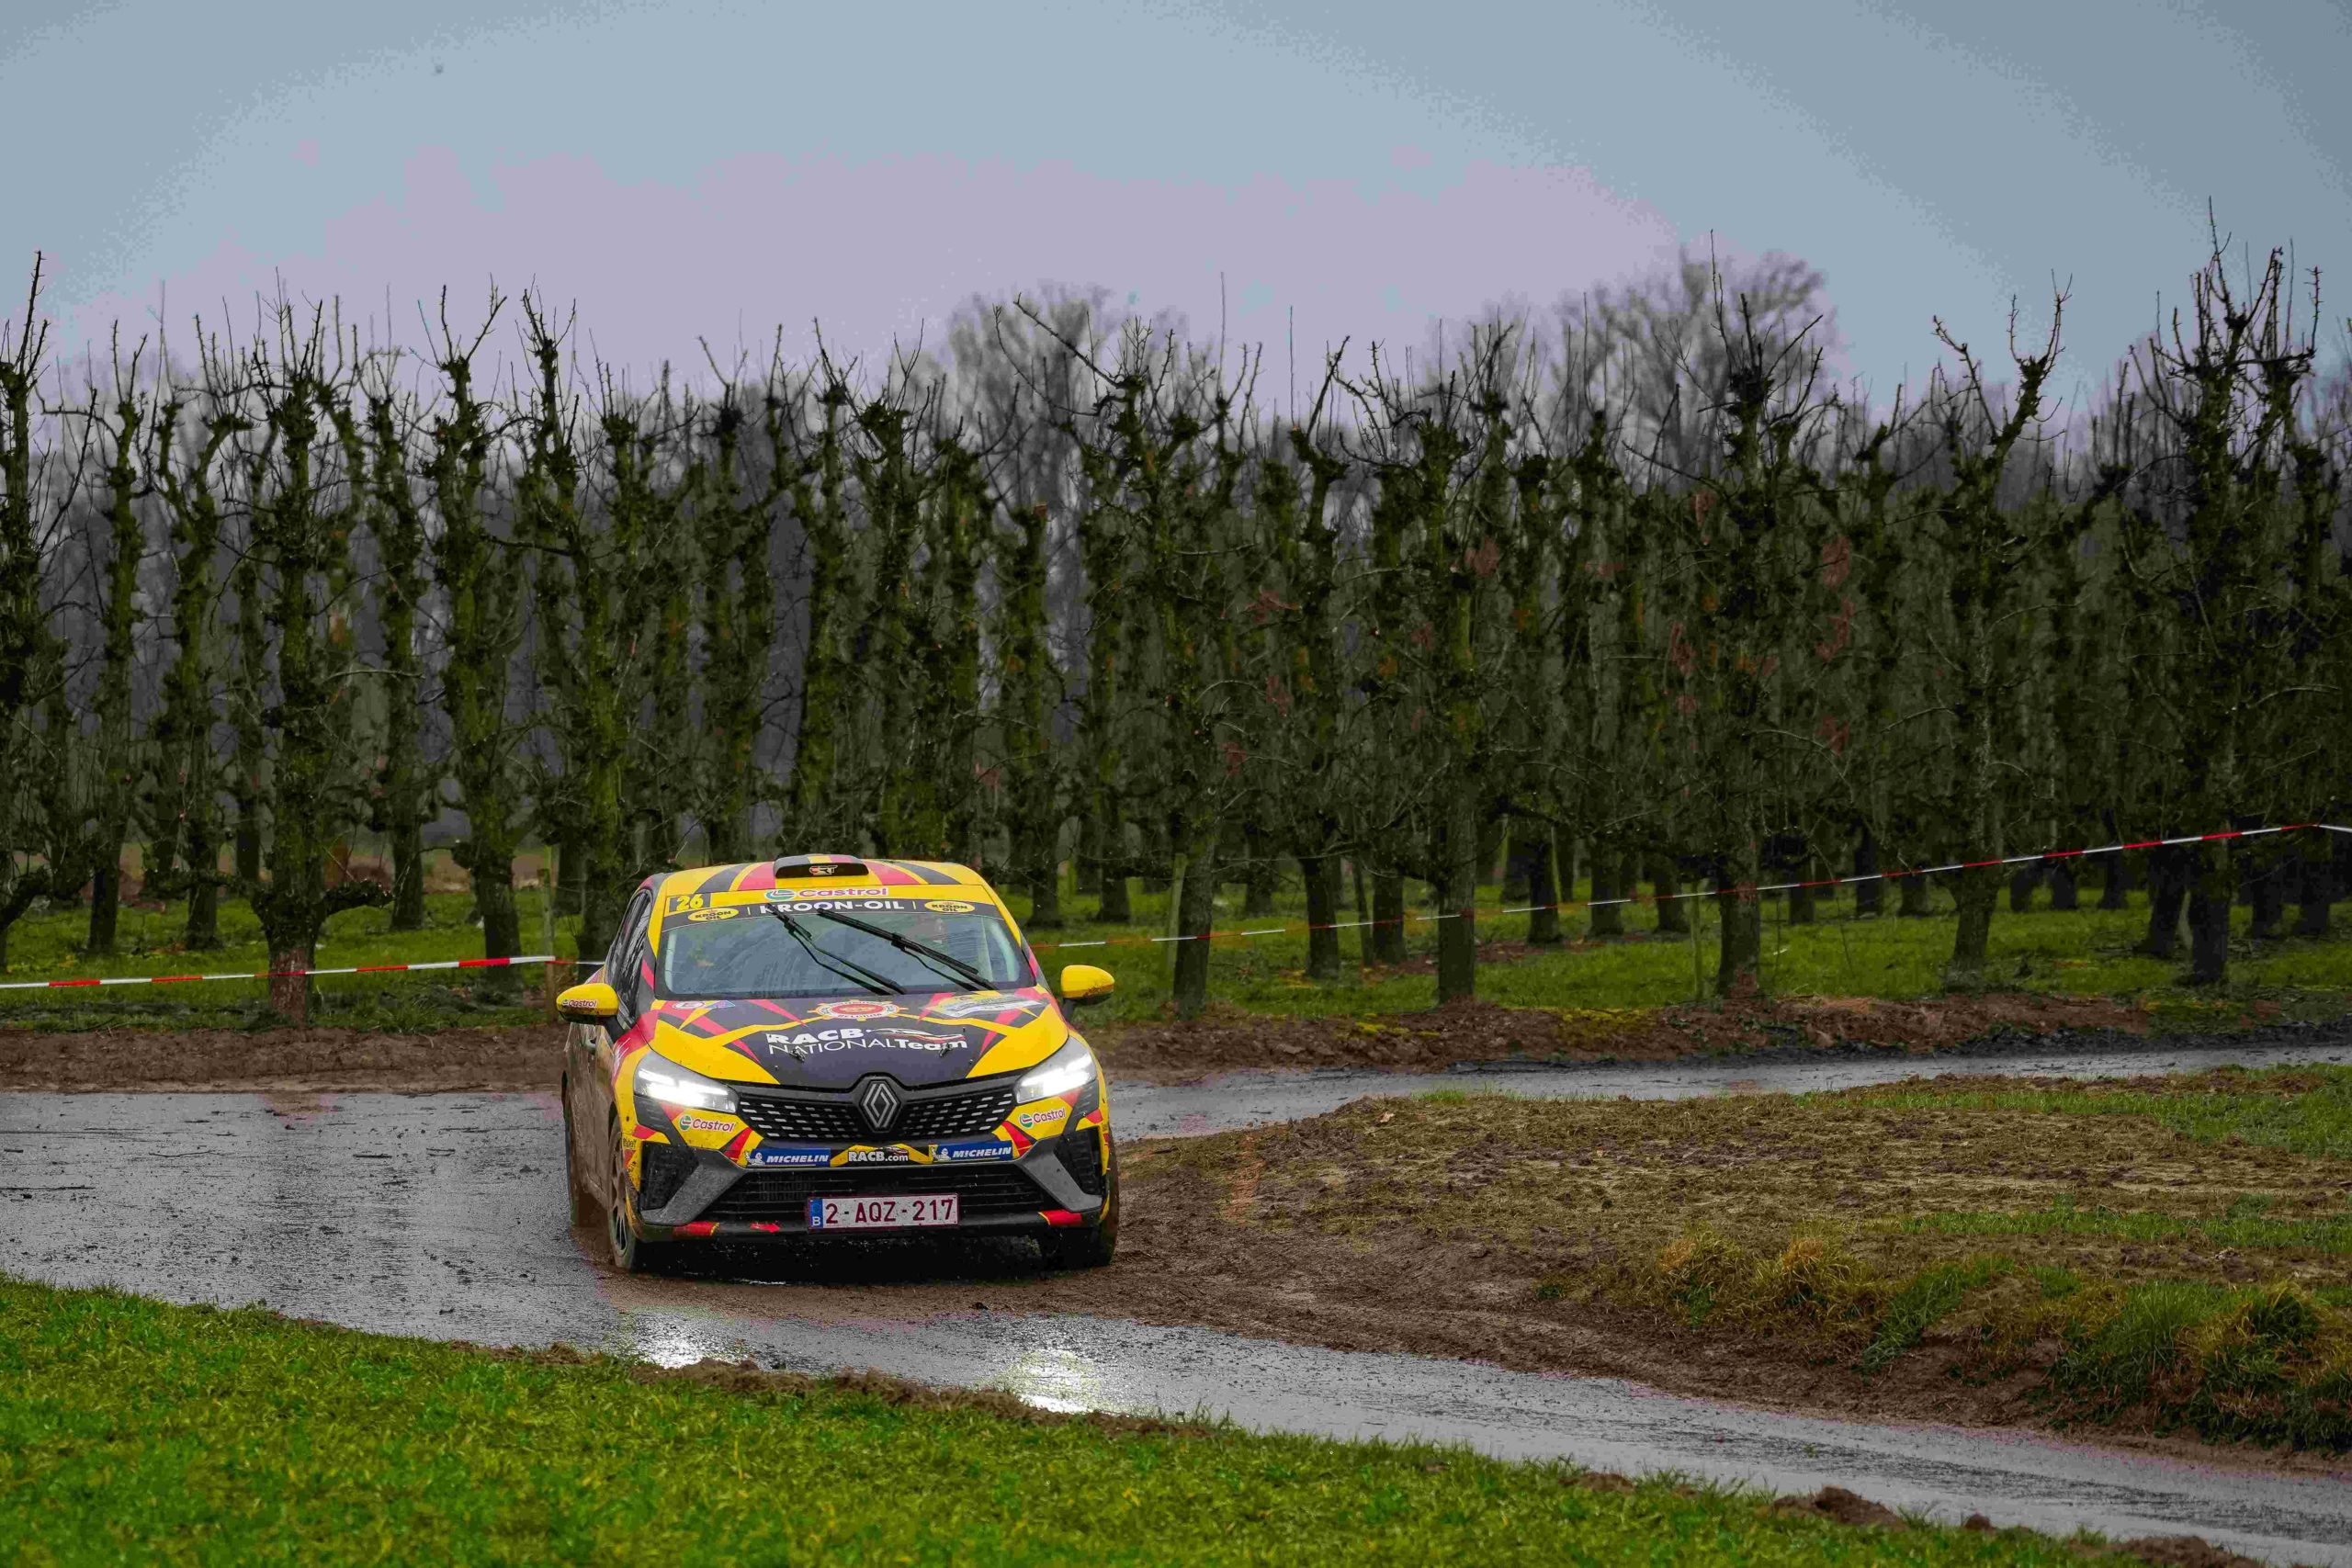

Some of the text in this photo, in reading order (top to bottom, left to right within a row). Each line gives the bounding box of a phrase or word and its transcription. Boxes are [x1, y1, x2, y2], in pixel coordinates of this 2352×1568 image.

[798, 888, 888, 897] Castrol
[676, 894, 704, 912] 26
[759, 900, 904, 914] KROON-OIL
[695, 910, 731, 919] KROON
[569, 999, 596, 1008] Castrol
[765, 1028, 865, 1044] RACB
[1034, 1108, 1067, 1123] Castrol
[692, 1118, 735, 1133] Castrol
[848, 1150, 909, 1162] RACB.com
[952, 1146, 1012, 1158] MICHELIN
[766, 1154, 830, 1164] MICHELIN
[811, 1216, 821, 1227] B
